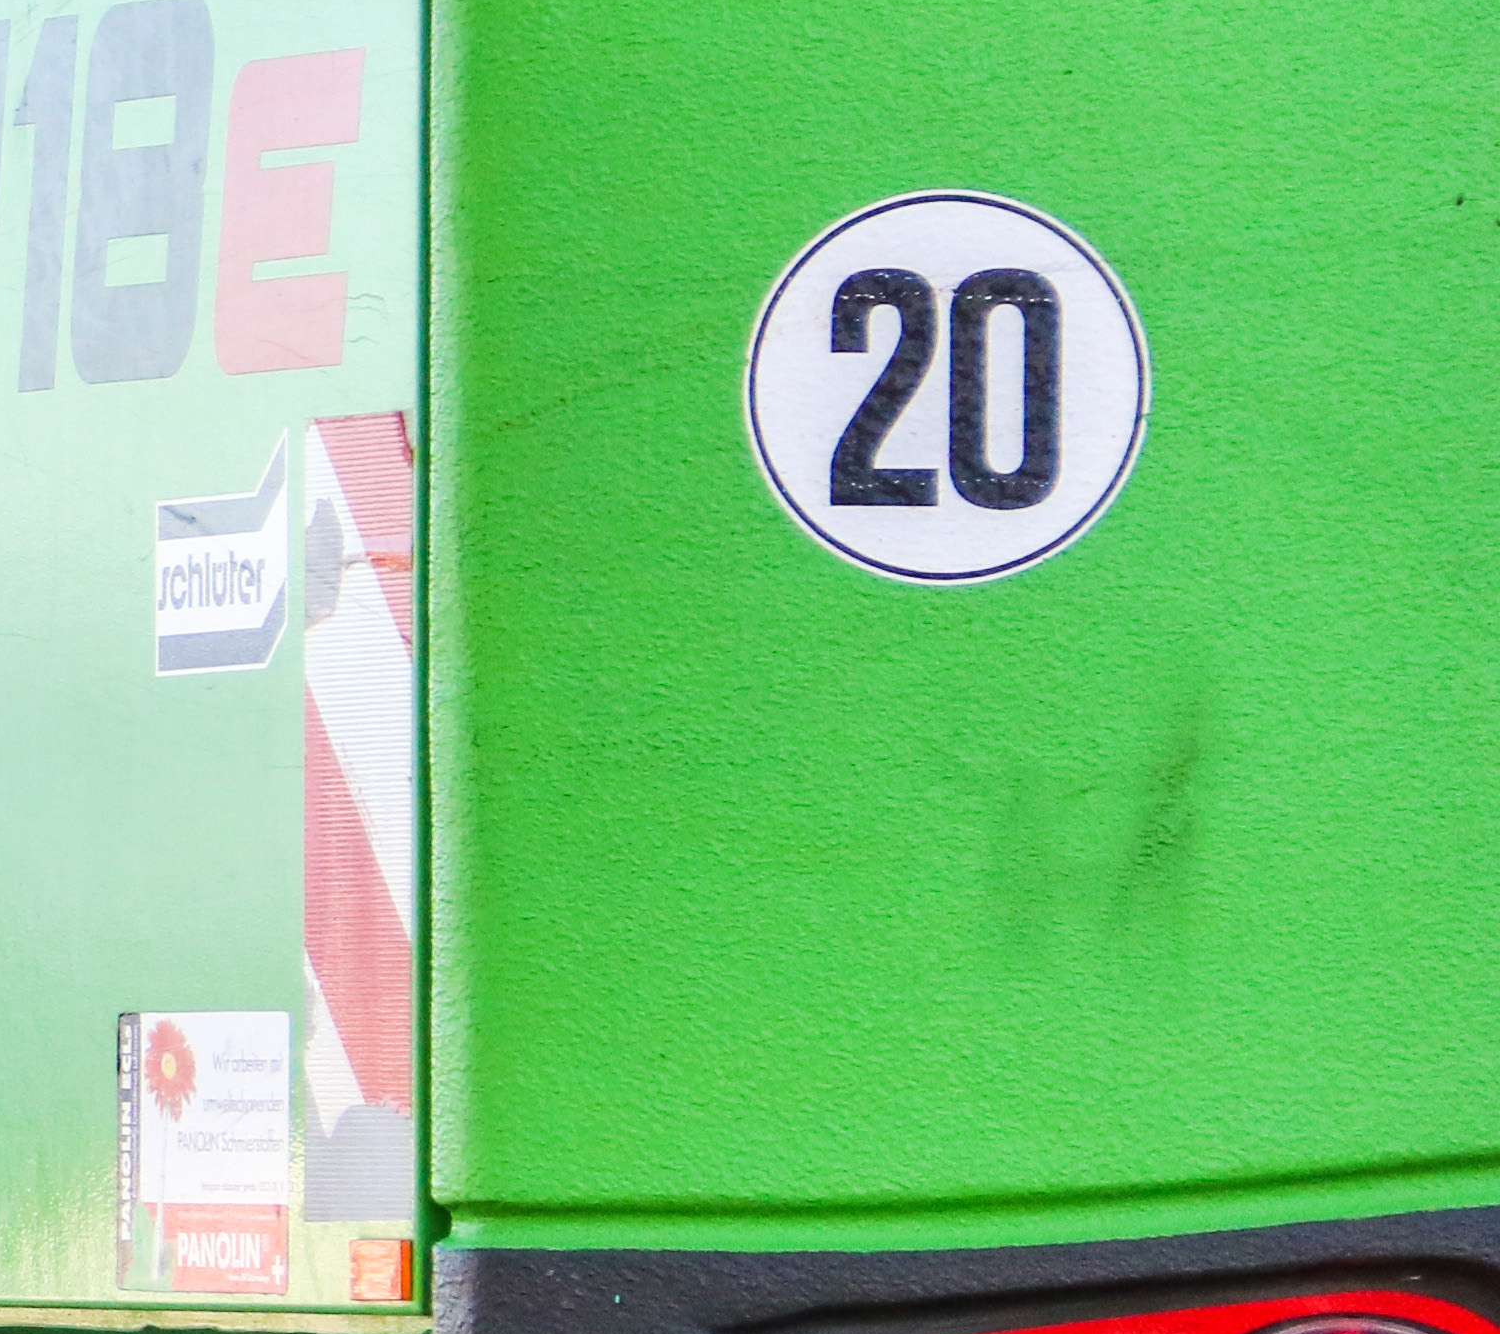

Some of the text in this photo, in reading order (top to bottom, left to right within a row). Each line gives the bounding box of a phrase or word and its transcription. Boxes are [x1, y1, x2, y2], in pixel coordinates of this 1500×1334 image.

[829, 267, 1064, 510] 20
[120, 1102, 133, 1241] PANOLIN
[177, 1231, 261, 1269] PANOLIN
